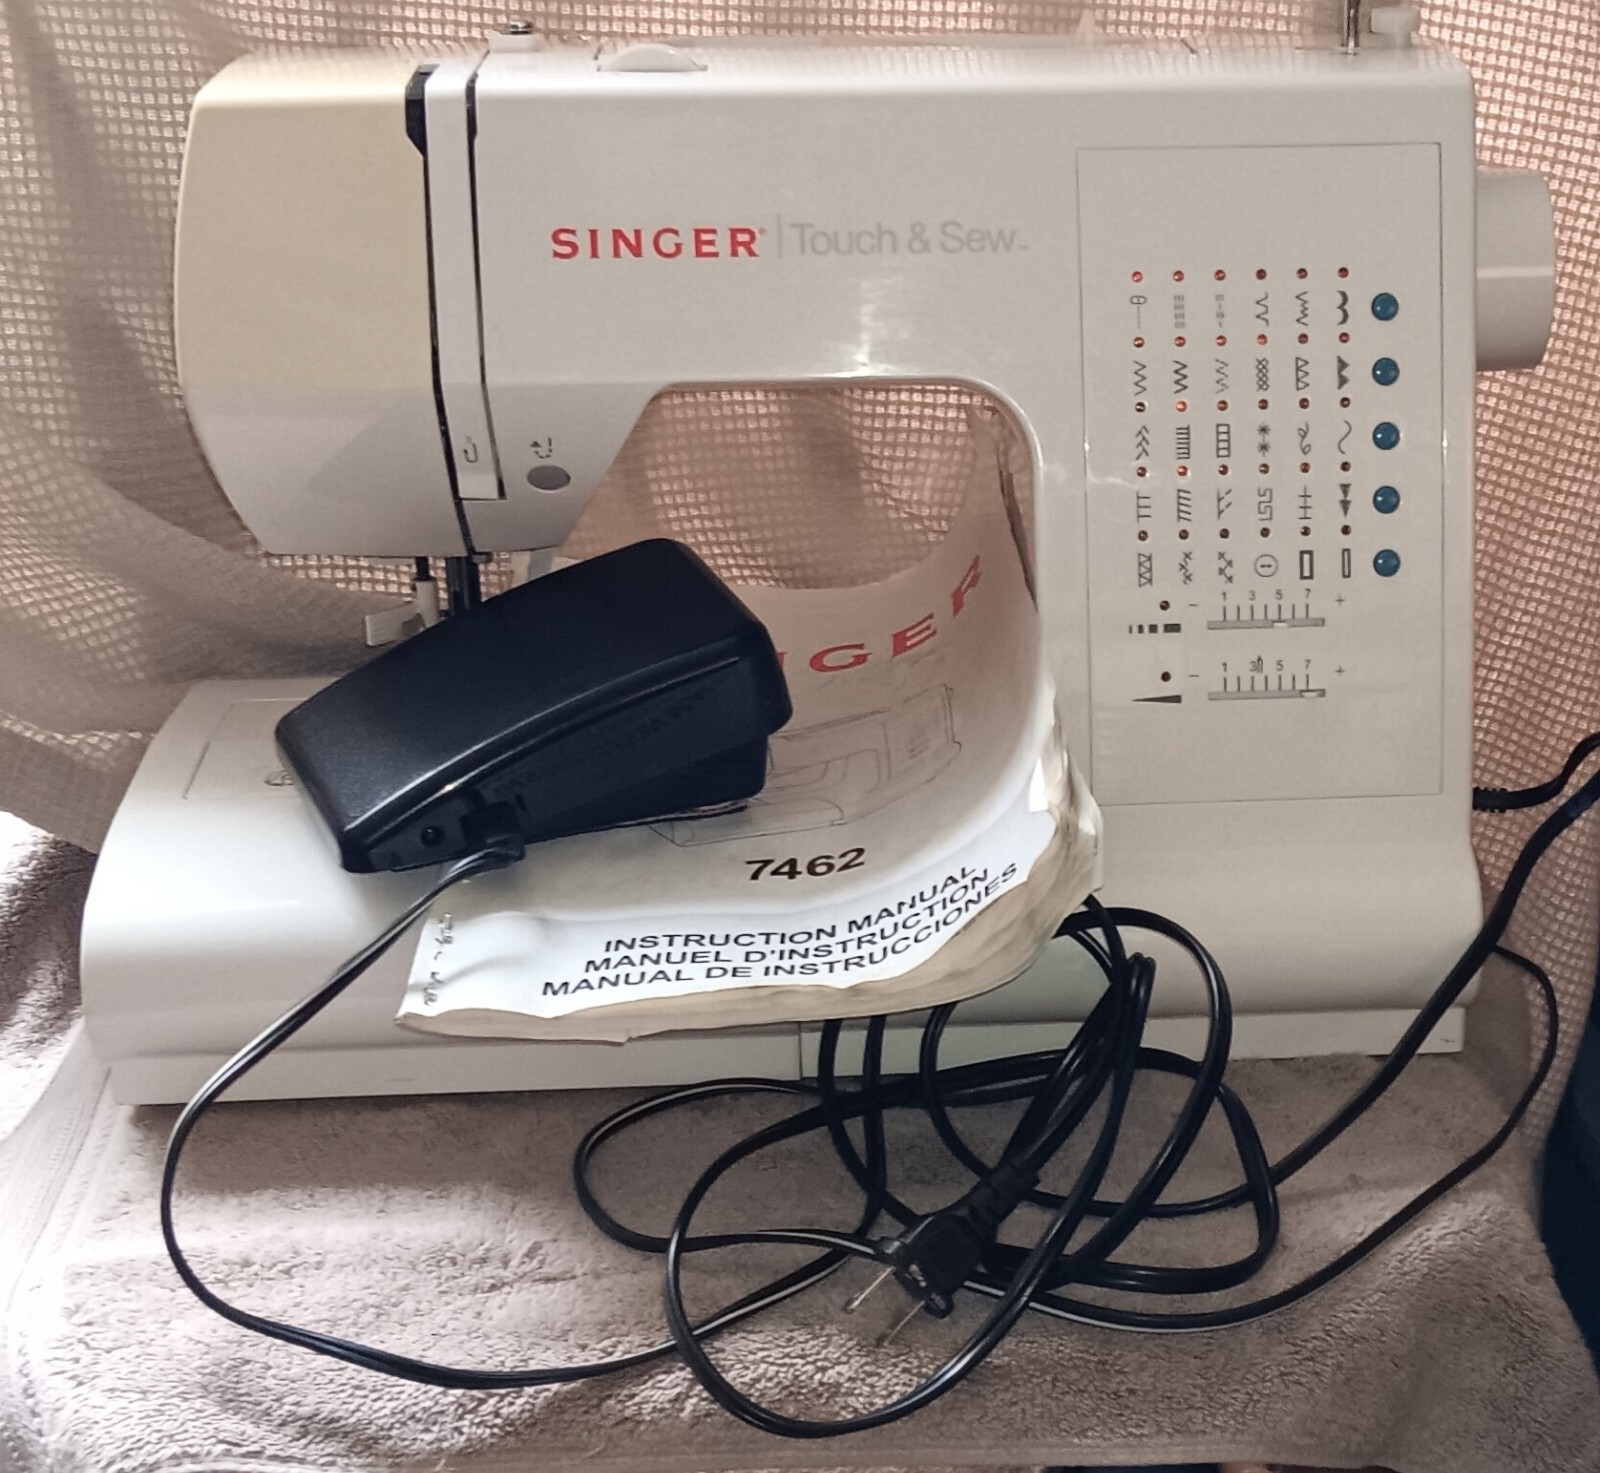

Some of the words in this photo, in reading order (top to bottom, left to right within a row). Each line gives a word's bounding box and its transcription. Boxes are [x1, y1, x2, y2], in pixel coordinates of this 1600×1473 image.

[551, 227, 763, 260] SINGER
[789, 223, 897, 256] Touch
[907, 223, 932, 255] &
[939, 220, 1015, 254] Sew
[1221, 591, 1227, 601] 1
[1249, 590, 1257, 601] 3
[1275, 589, 1283, 600] 5
[1304, 588, 1312, 599] 7
[1222, 662, 1228, 672] 1
[1276, 660, 1284, 671] 5
[1304, 659, 1312, 670] 7
[744, 847, 866, 881] 7462
[541, 966, 694, 997] MANUAL
[705, 963, 753, 979] DE
[763, 862, 1018, 978] INSTRUCCIONES
[584, 948, 733, 973] MANUEL
[743, 868, 990, 963] D'INSTRUCTION
[604, 924, 836, 953] INSTRUCTION
[847, 866, 976, 934] MANUAL
